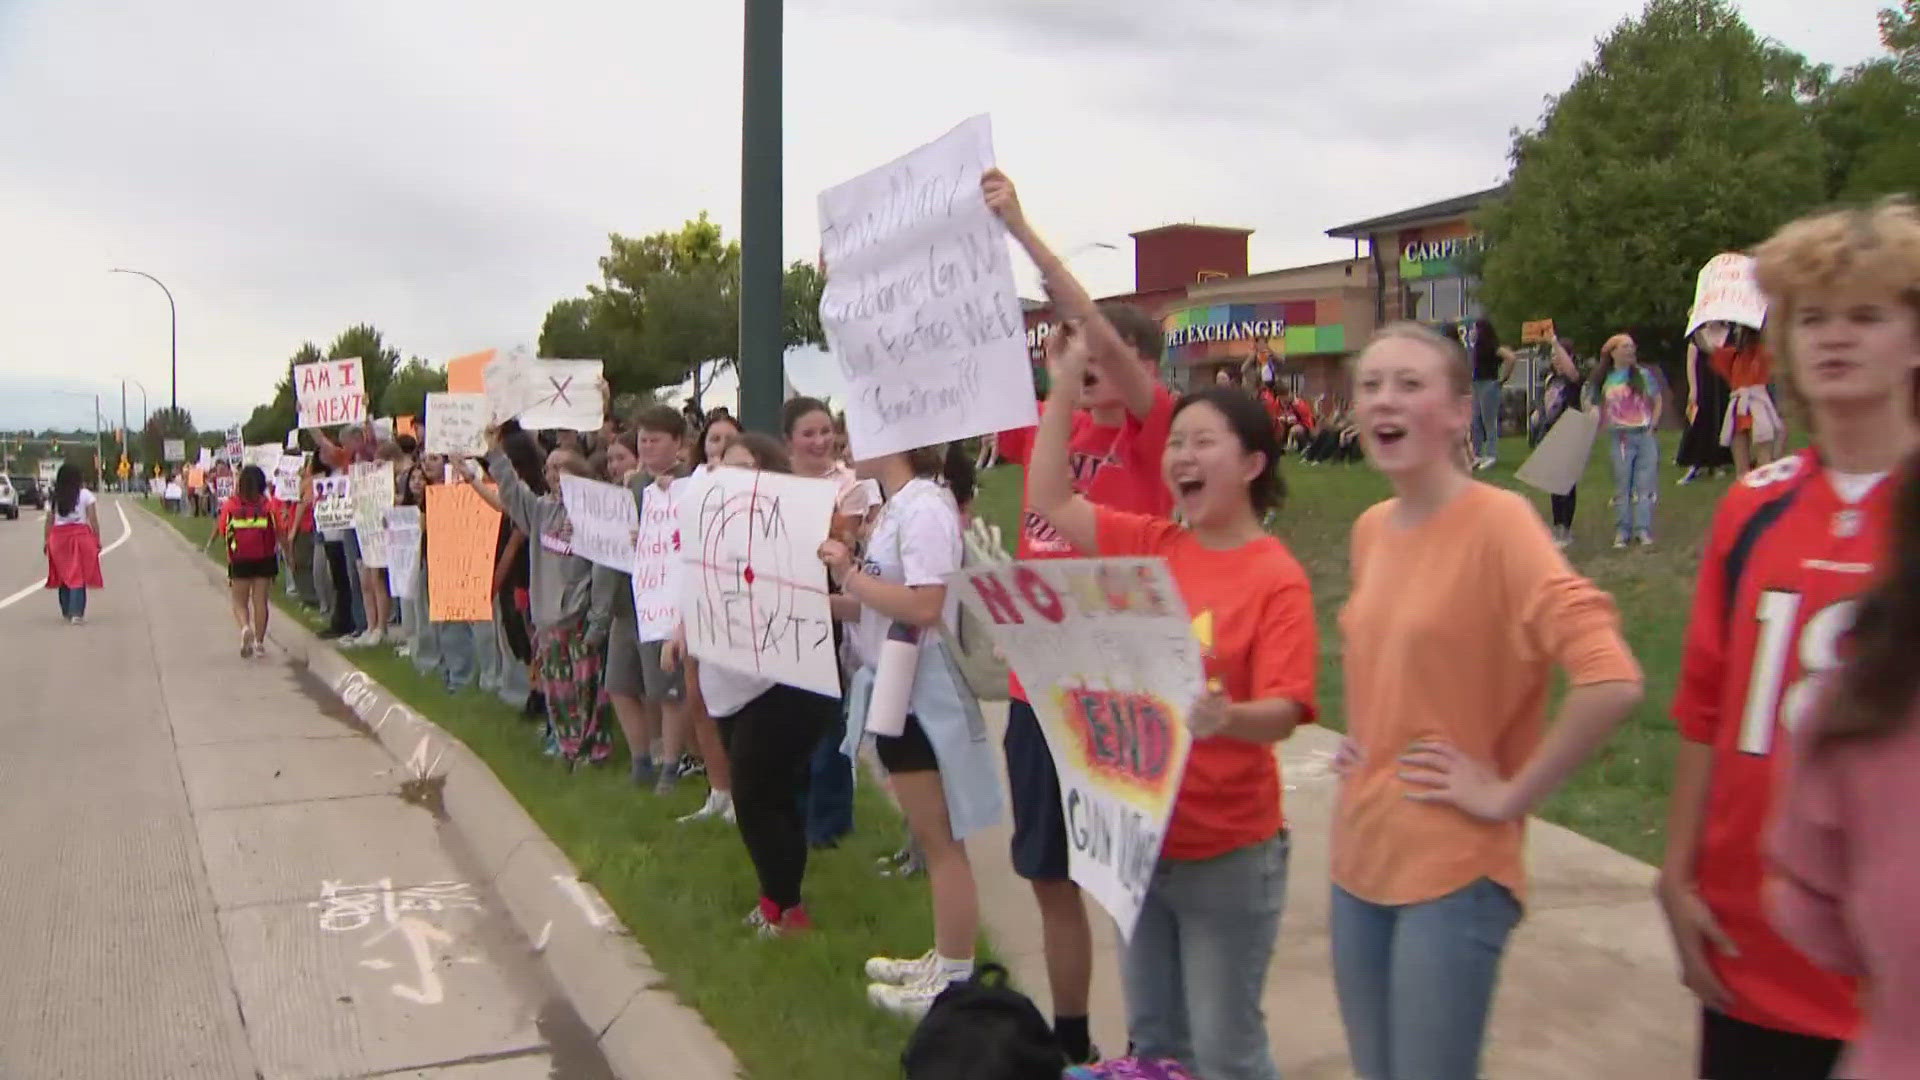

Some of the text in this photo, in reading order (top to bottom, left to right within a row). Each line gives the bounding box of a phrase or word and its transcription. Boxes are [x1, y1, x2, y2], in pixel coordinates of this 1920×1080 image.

[1187, 318, 1285, 343] EXCHANGE
[303, 362, 355, 394] AM I
[316, 394, 362, 424] NEXT
[699, 484, 781, 541] AM
[722, 555, 752, 595] I
[969, 565, 1066, 625] NO
[1082, 696, 1169, 778] END
